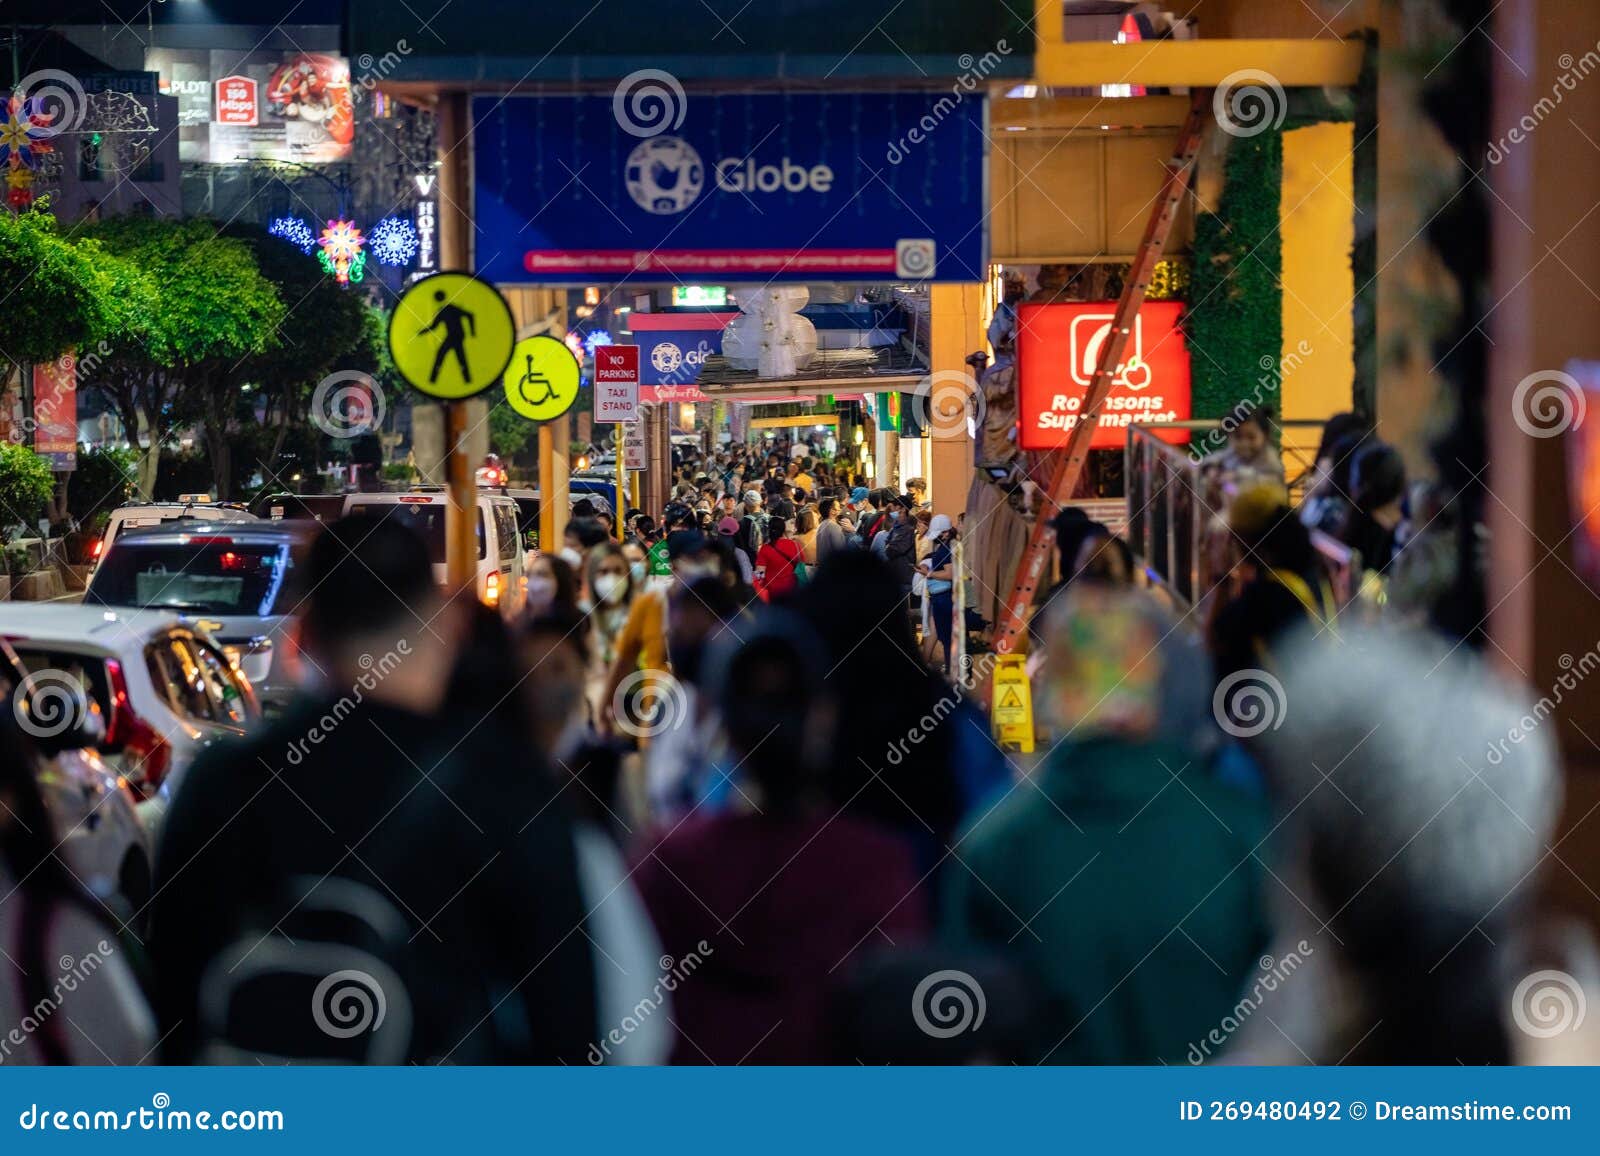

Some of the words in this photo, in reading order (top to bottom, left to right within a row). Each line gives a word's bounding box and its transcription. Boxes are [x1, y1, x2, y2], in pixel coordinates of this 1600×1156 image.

[715, 157, 834, 192] Globe
[415, 175, 436, 196] V
[417, 201, 435, 268] HOTEL
[610, 356, 625, 365] NO
[599, 369, 636, 379] PARKING
[607, 388, 628, 397] TAXI
[602, 402, 633, 411] STAND
[1052, 394, 1164, 411] Ronsons
[1038, 410, 1177, 431] Supmarket
